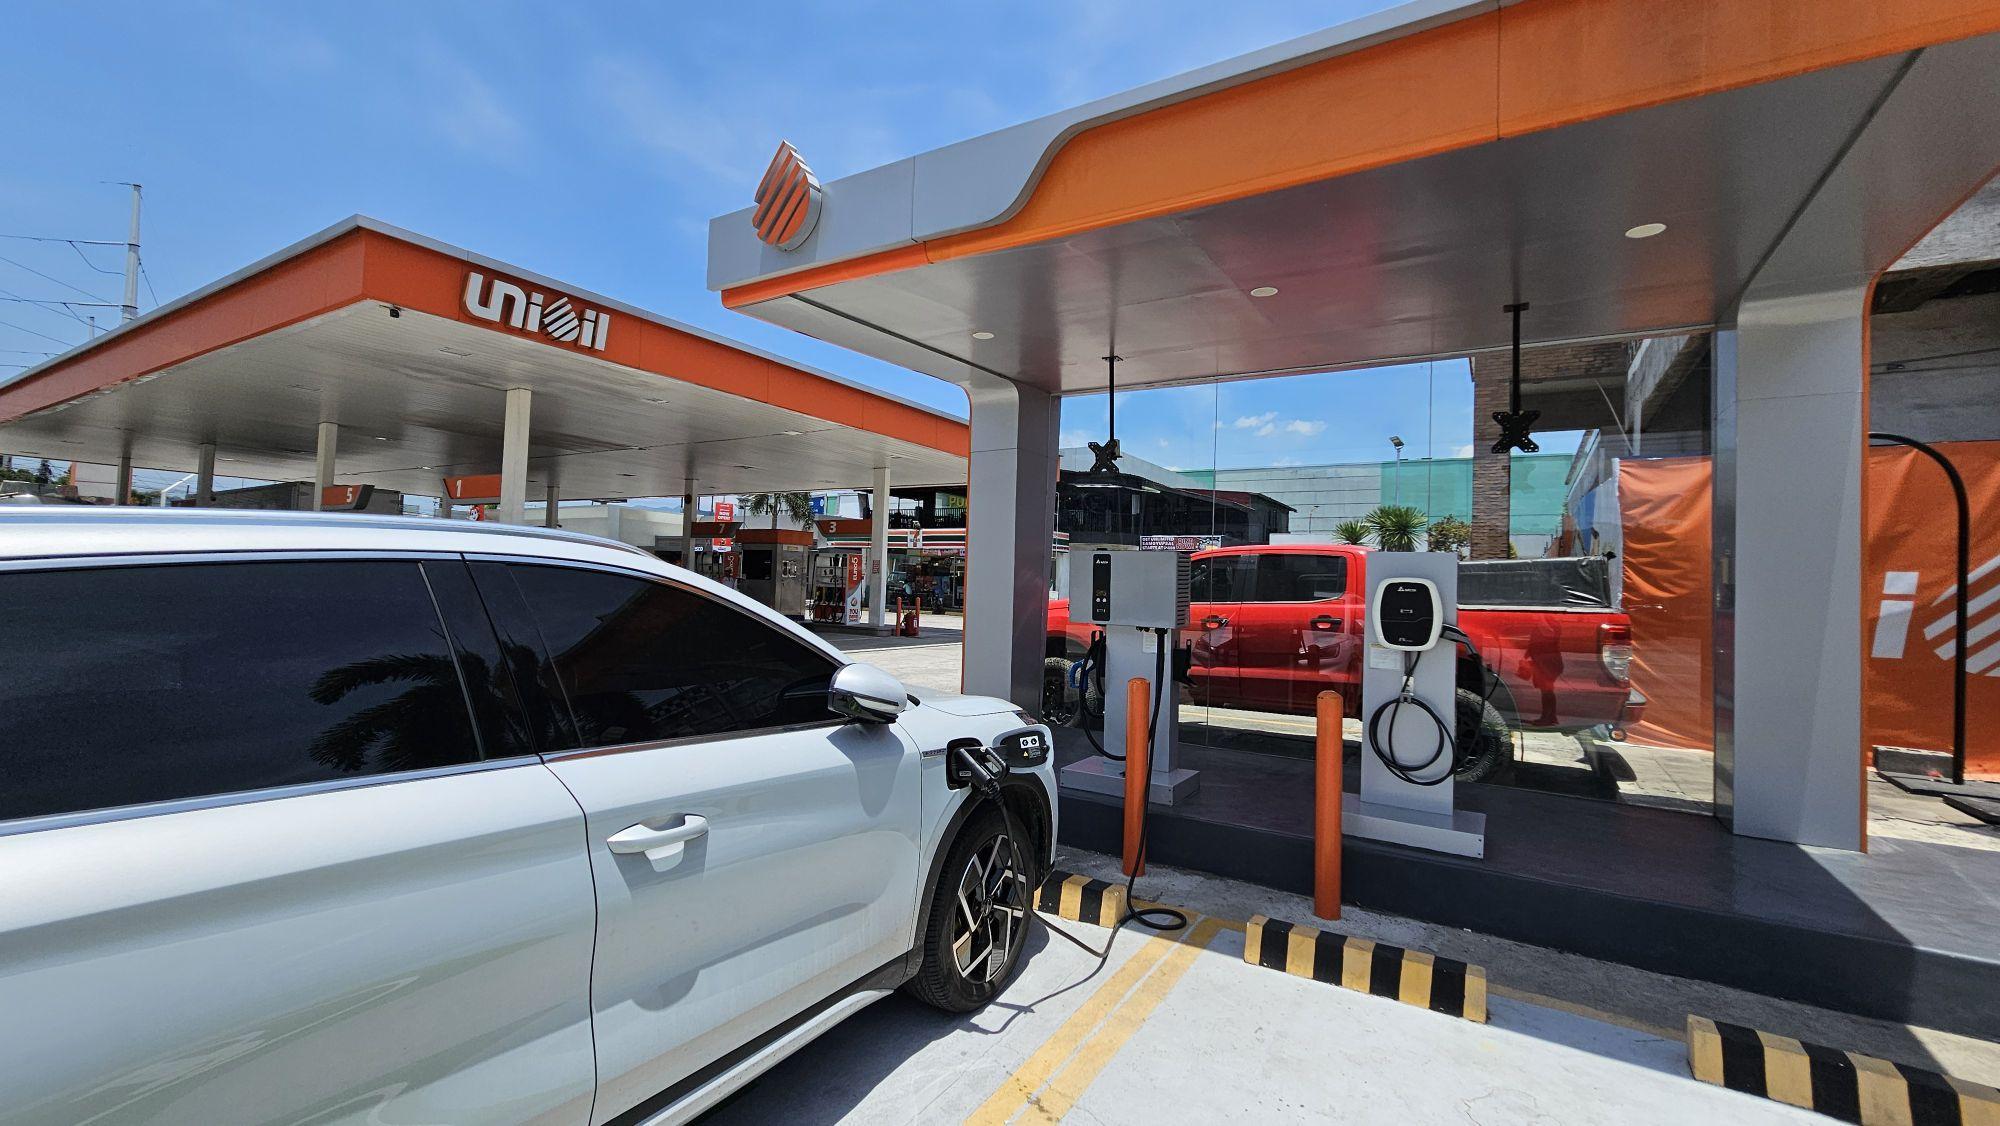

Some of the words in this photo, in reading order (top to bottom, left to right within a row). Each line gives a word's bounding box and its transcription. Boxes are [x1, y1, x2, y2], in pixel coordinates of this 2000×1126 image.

[456, 479, 462, 497] 1
[346, 488, 353, 503] 5
[719, 523, 726, 534] 7
[828, 521, 837, 533] 3
